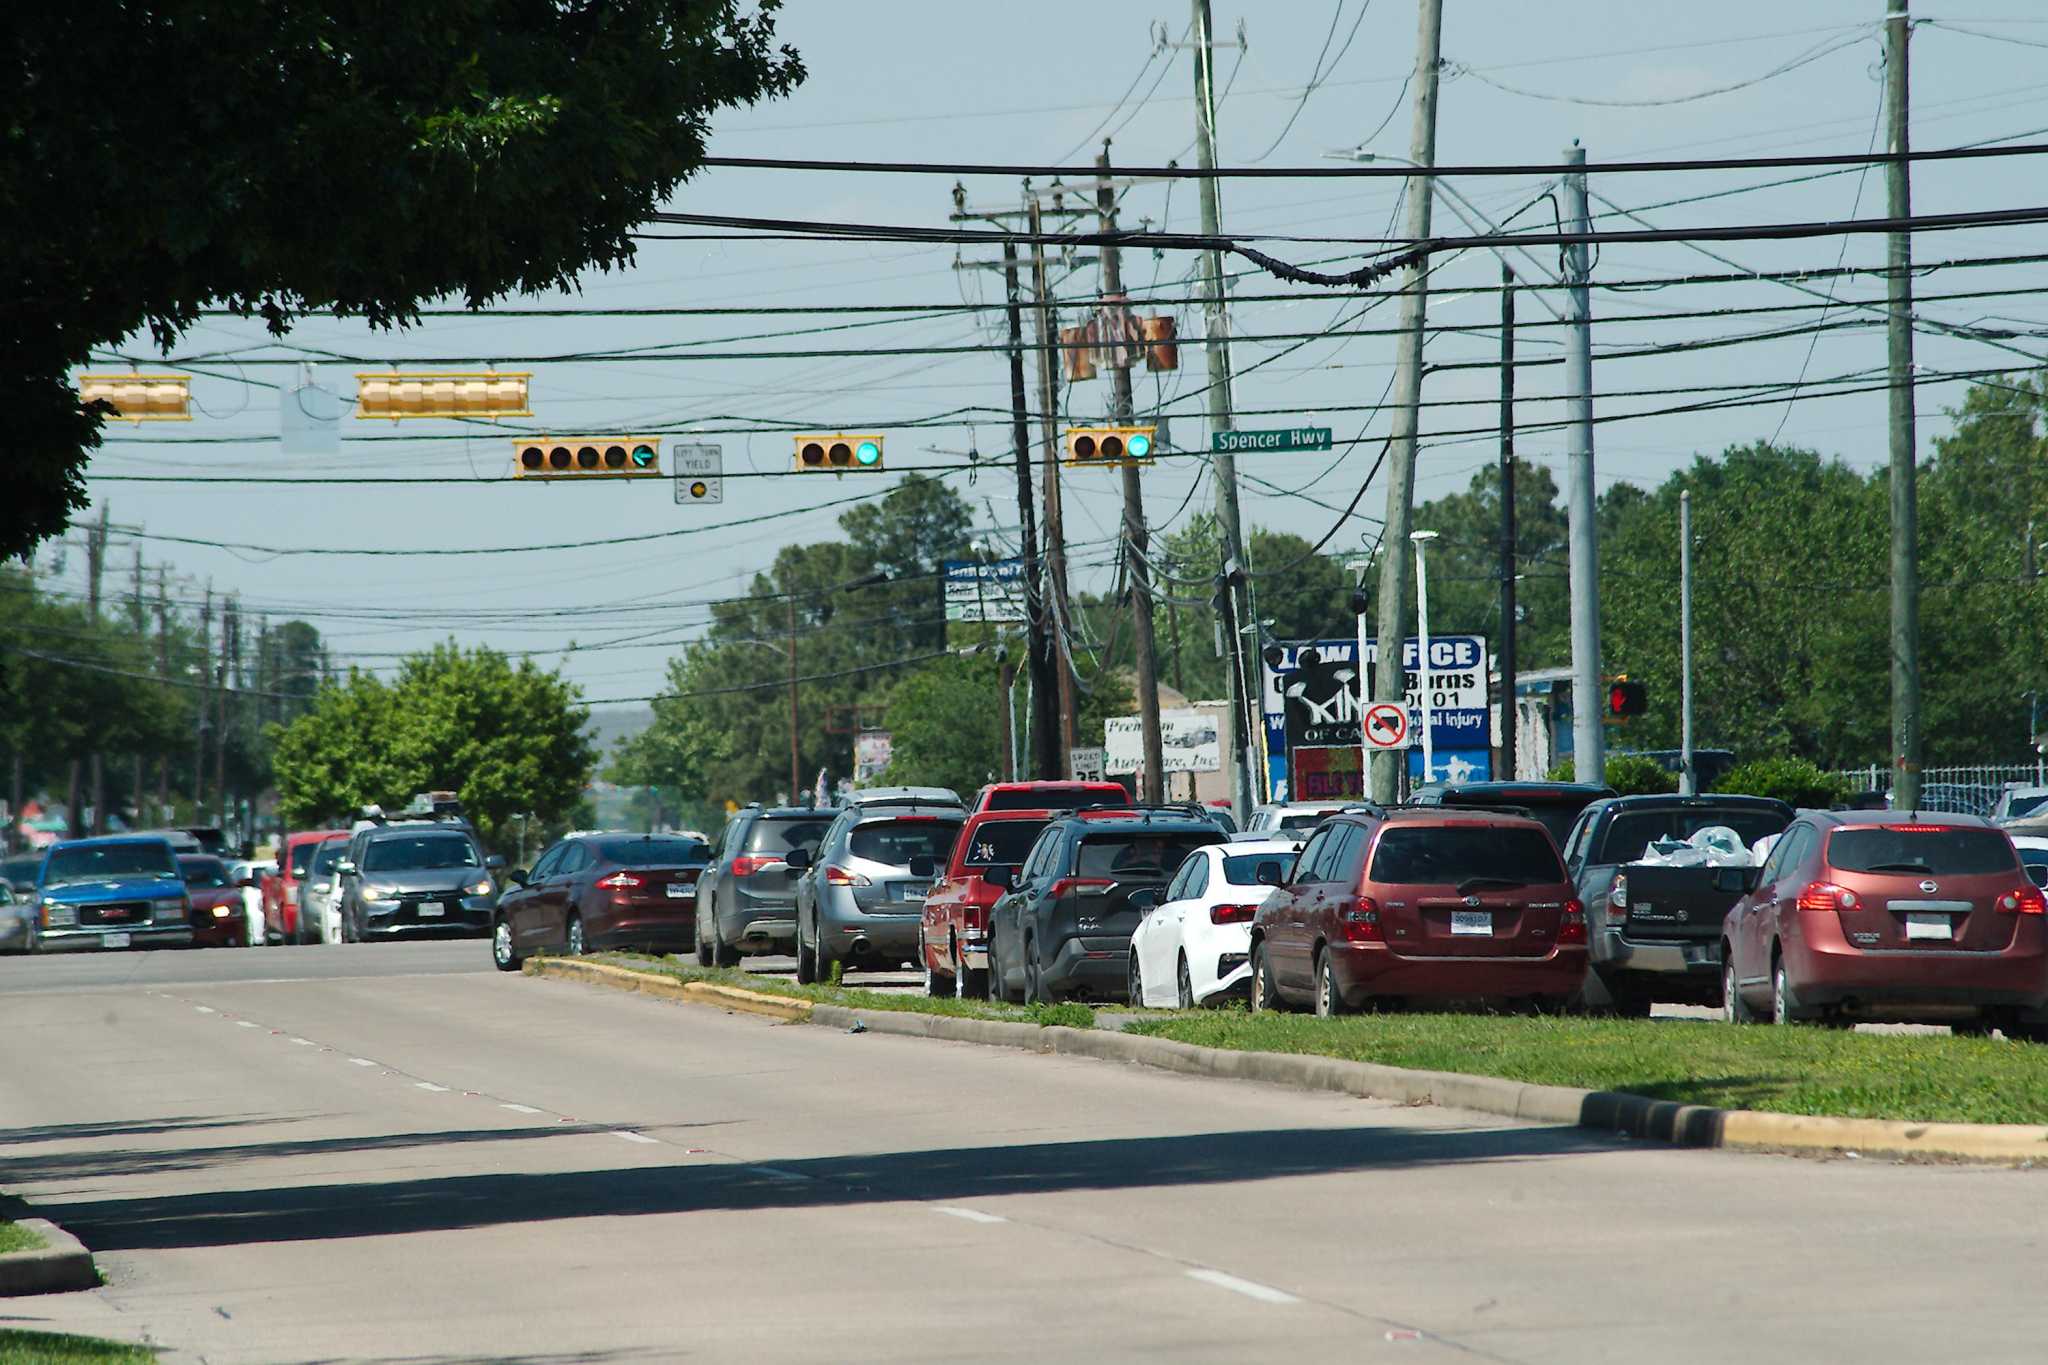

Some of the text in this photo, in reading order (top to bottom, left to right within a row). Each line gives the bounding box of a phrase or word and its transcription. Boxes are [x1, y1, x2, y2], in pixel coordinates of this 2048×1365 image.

[1219, 430, 1326, 451] Spencer Hwy
[685, 459, 712, 469] YIELD
[1445, 712, 1483, 729] Injury
[1304, 728, 1331, 742] OF
